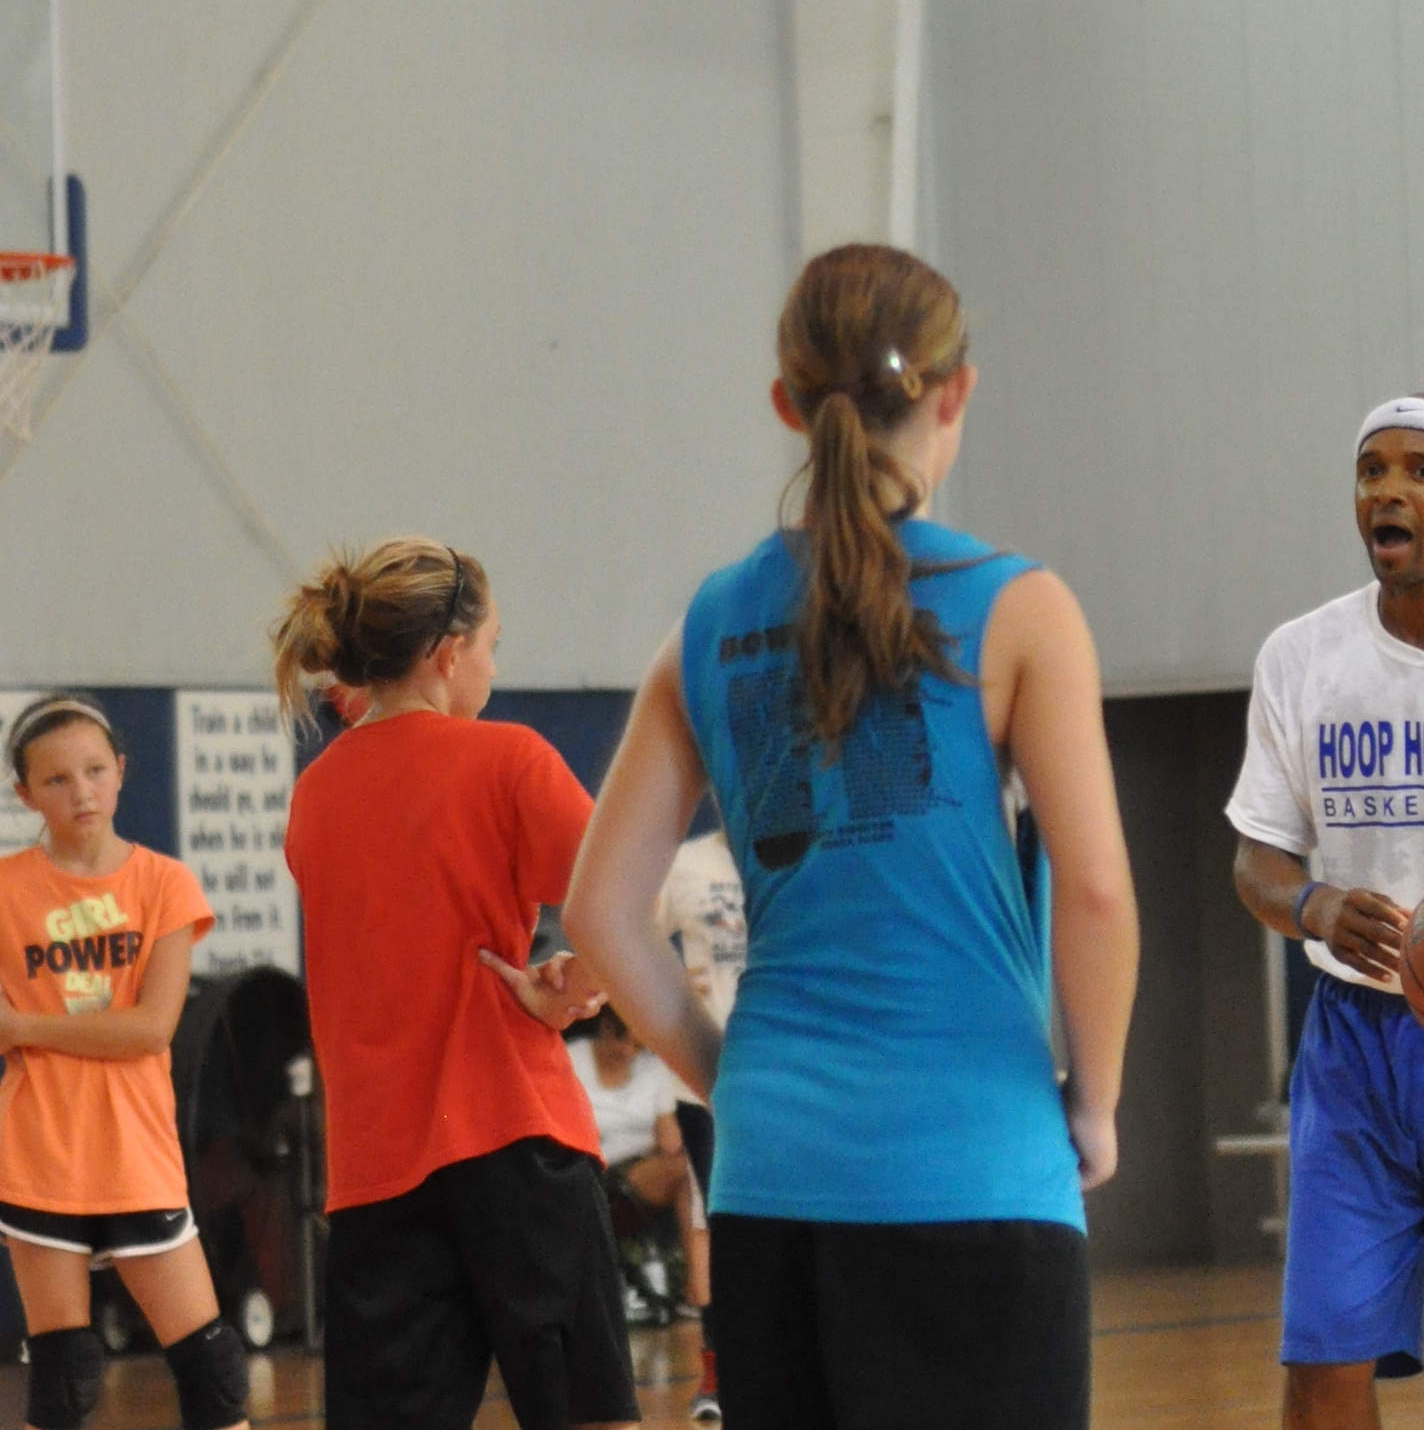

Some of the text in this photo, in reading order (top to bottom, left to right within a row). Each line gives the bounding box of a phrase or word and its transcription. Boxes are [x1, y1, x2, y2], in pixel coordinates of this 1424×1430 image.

[1319, 720, 1394, 779] HOOP
[45, 891, 129, 943] GIRL
[24, 930, 144, 980] POWER
